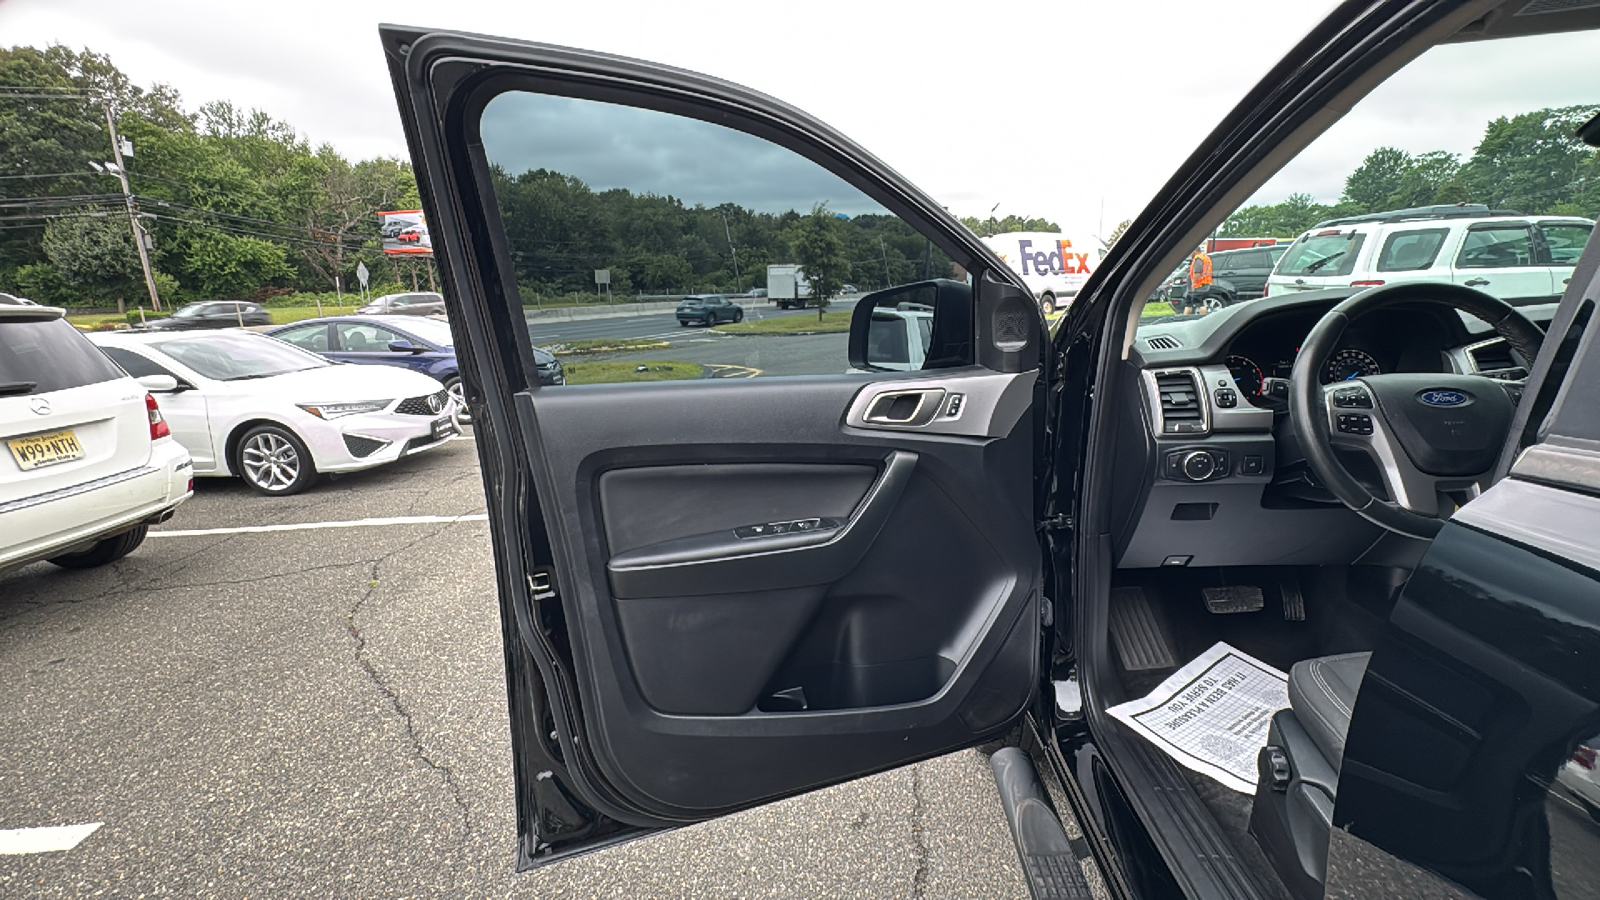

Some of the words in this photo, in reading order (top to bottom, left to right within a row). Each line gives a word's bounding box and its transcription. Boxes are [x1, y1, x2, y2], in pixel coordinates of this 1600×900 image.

[1018, 240, 1092, 276] FedEx
[1432, 392, 1458, 402] Ford
[1204, 676, 1219, 688] TO
[1222, 676, 1240, 690] HAS
[1182, 685, 1207, 703] SERVE
[1205, 688, 1227, 705] BEEN
[1167, 700, 1189, 714] YOU
[1164, 705, 1203, 731] PLEASURE
